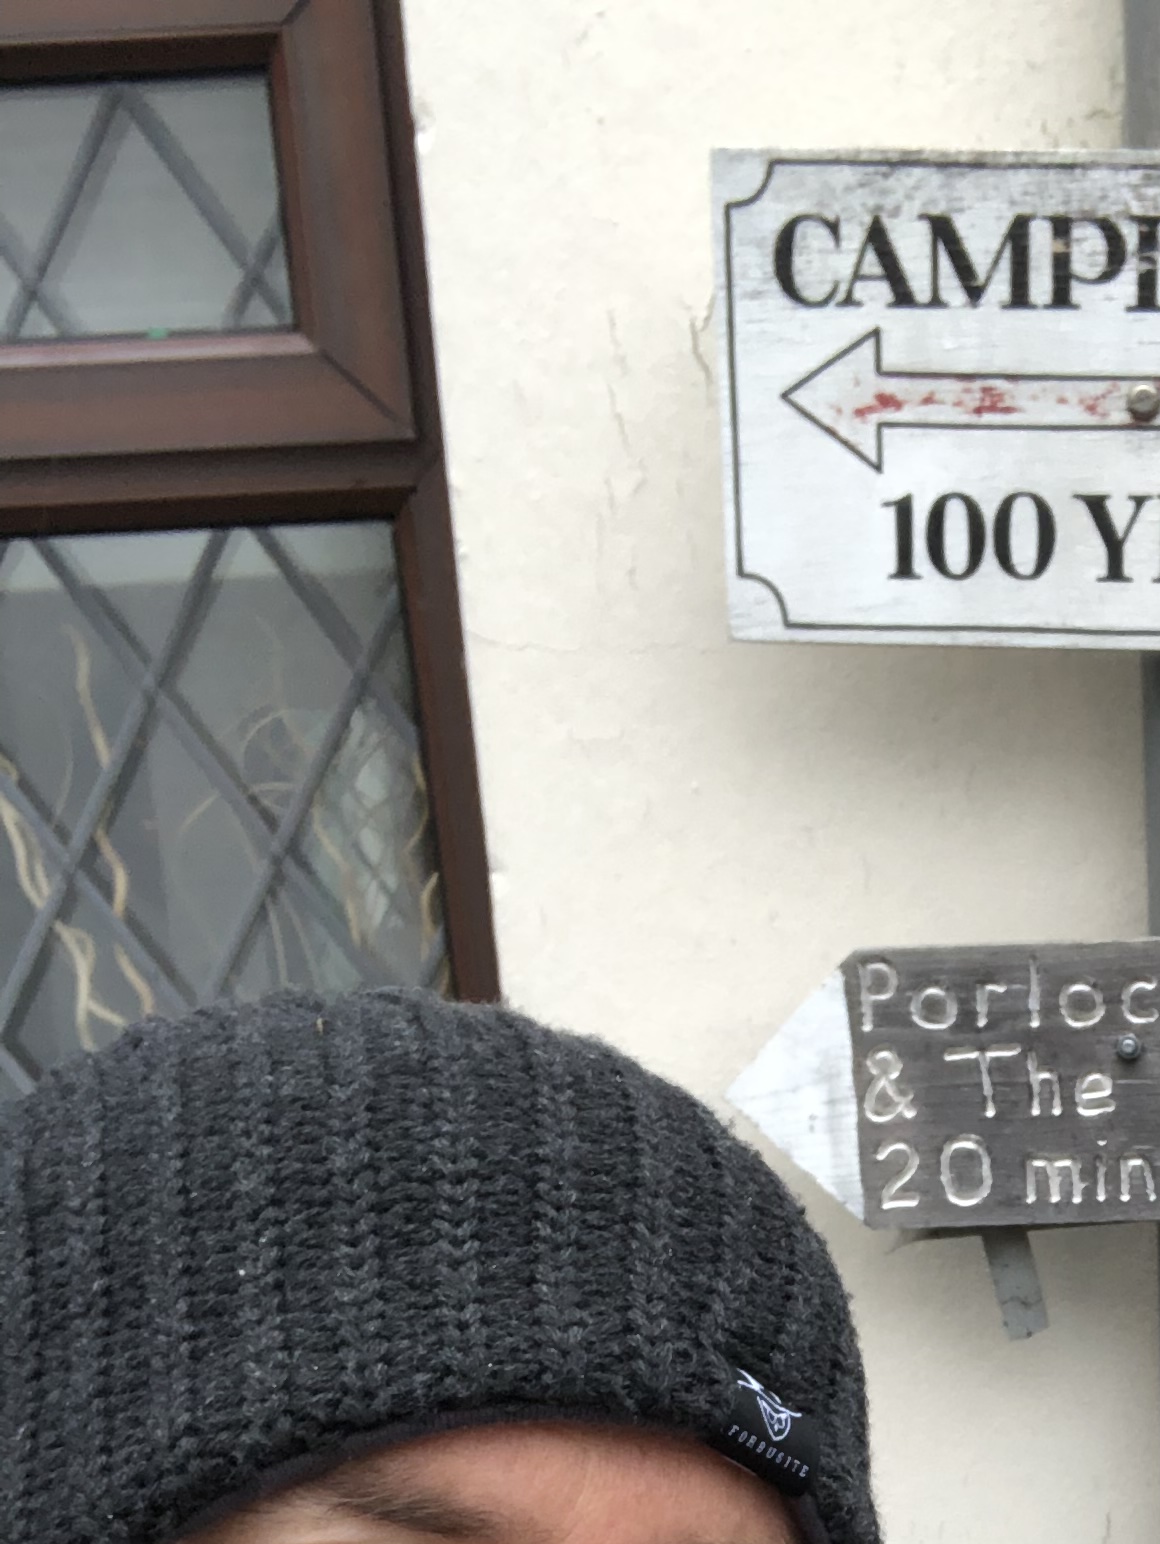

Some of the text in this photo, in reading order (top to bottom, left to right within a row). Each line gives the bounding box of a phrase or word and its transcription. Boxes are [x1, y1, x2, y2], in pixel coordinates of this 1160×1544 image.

[881, 491, 1056, 582] 100
[862, 1044, 919, 1123] &
[942, 1046, 1117, 1119] The
[874, 1132, 994, 1211] 20
[1023, 1138, 1158, 1205] min
